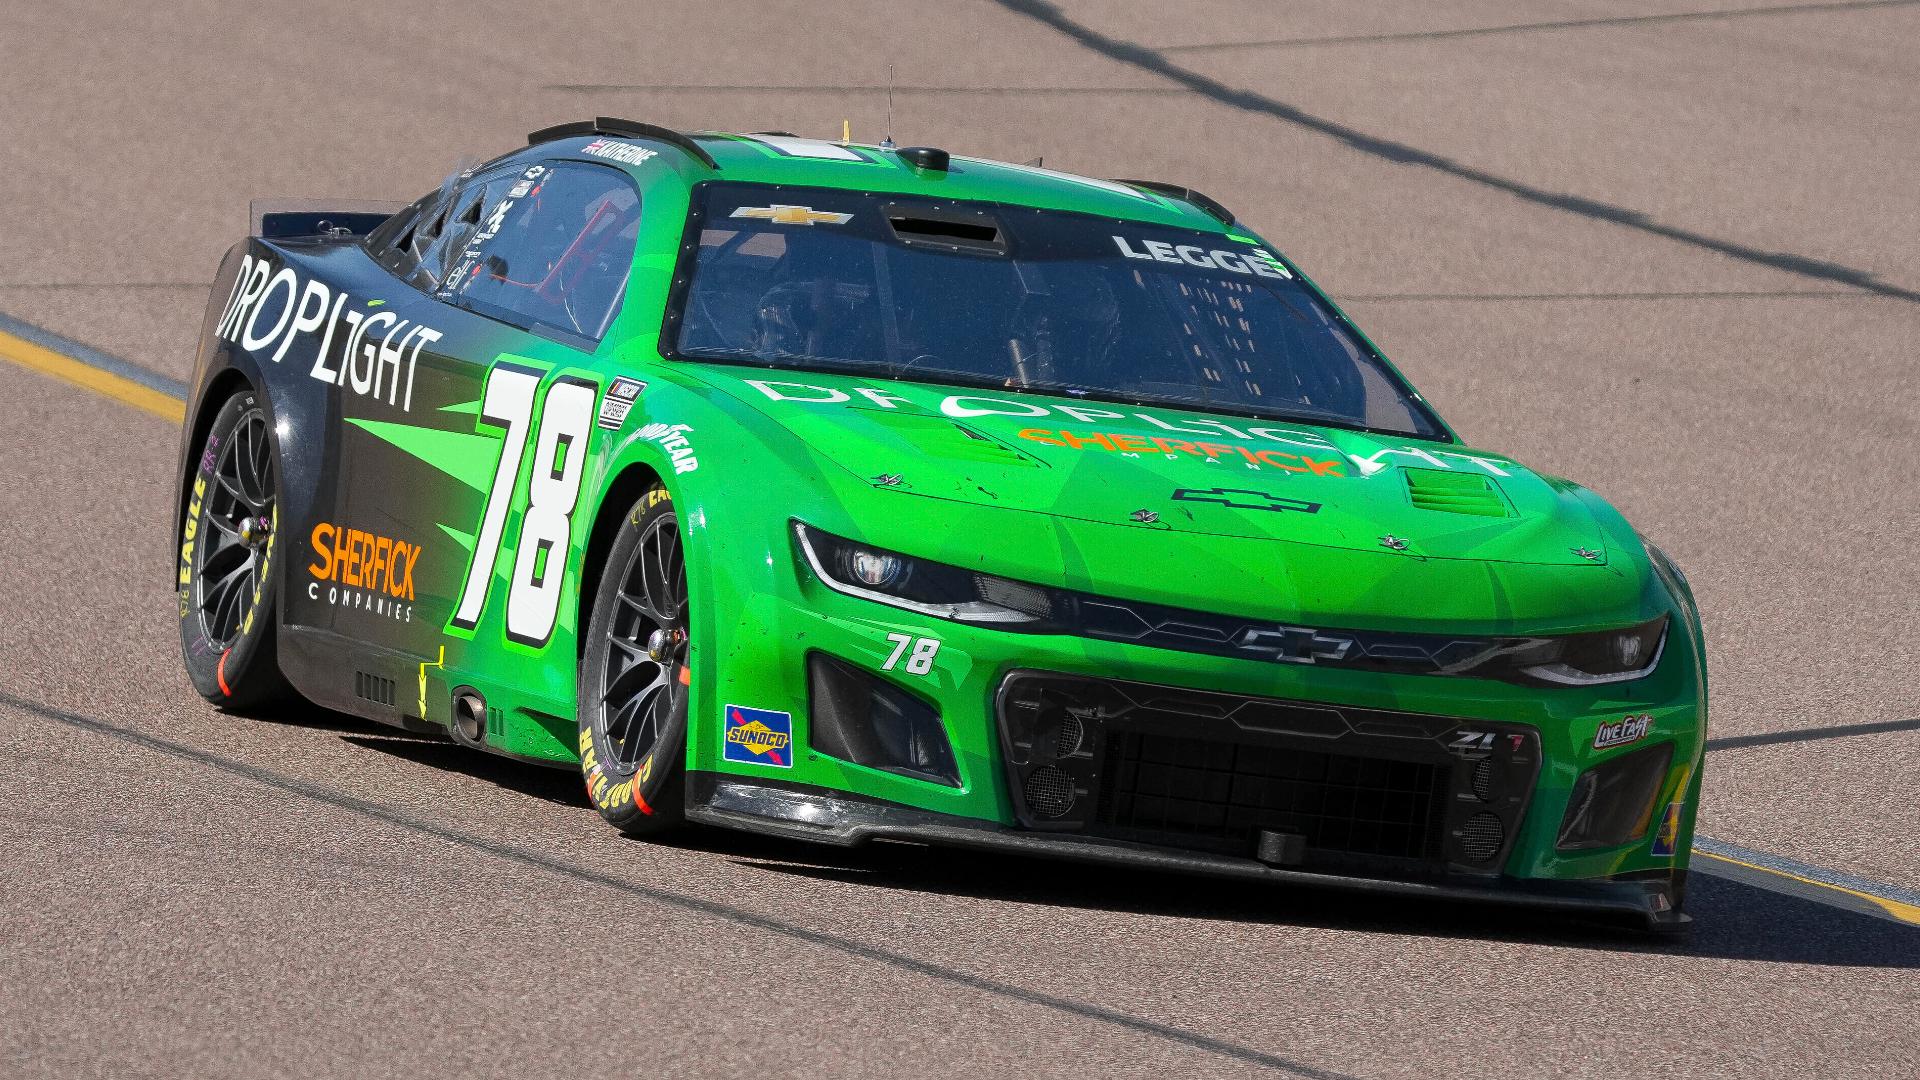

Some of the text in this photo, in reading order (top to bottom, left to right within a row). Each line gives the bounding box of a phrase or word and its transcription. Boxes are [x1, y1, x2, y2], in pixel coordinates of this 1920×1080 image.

[1112, 236, 1284, 280] LEGGE
[215, 254, 443, 413] DROPLIGHT
[1018, 428, 1344, 478] SHERFICK
[450, 360, 600, 650] 78
[179, 478, 206, 585] EAGLE
[308, 523, 421, 601] SHERFICK
[308, 582, 412, 622] COMPANIES
[881, 631, 942, 676] 78
[729, 727, 786, 748] SUNOCO
